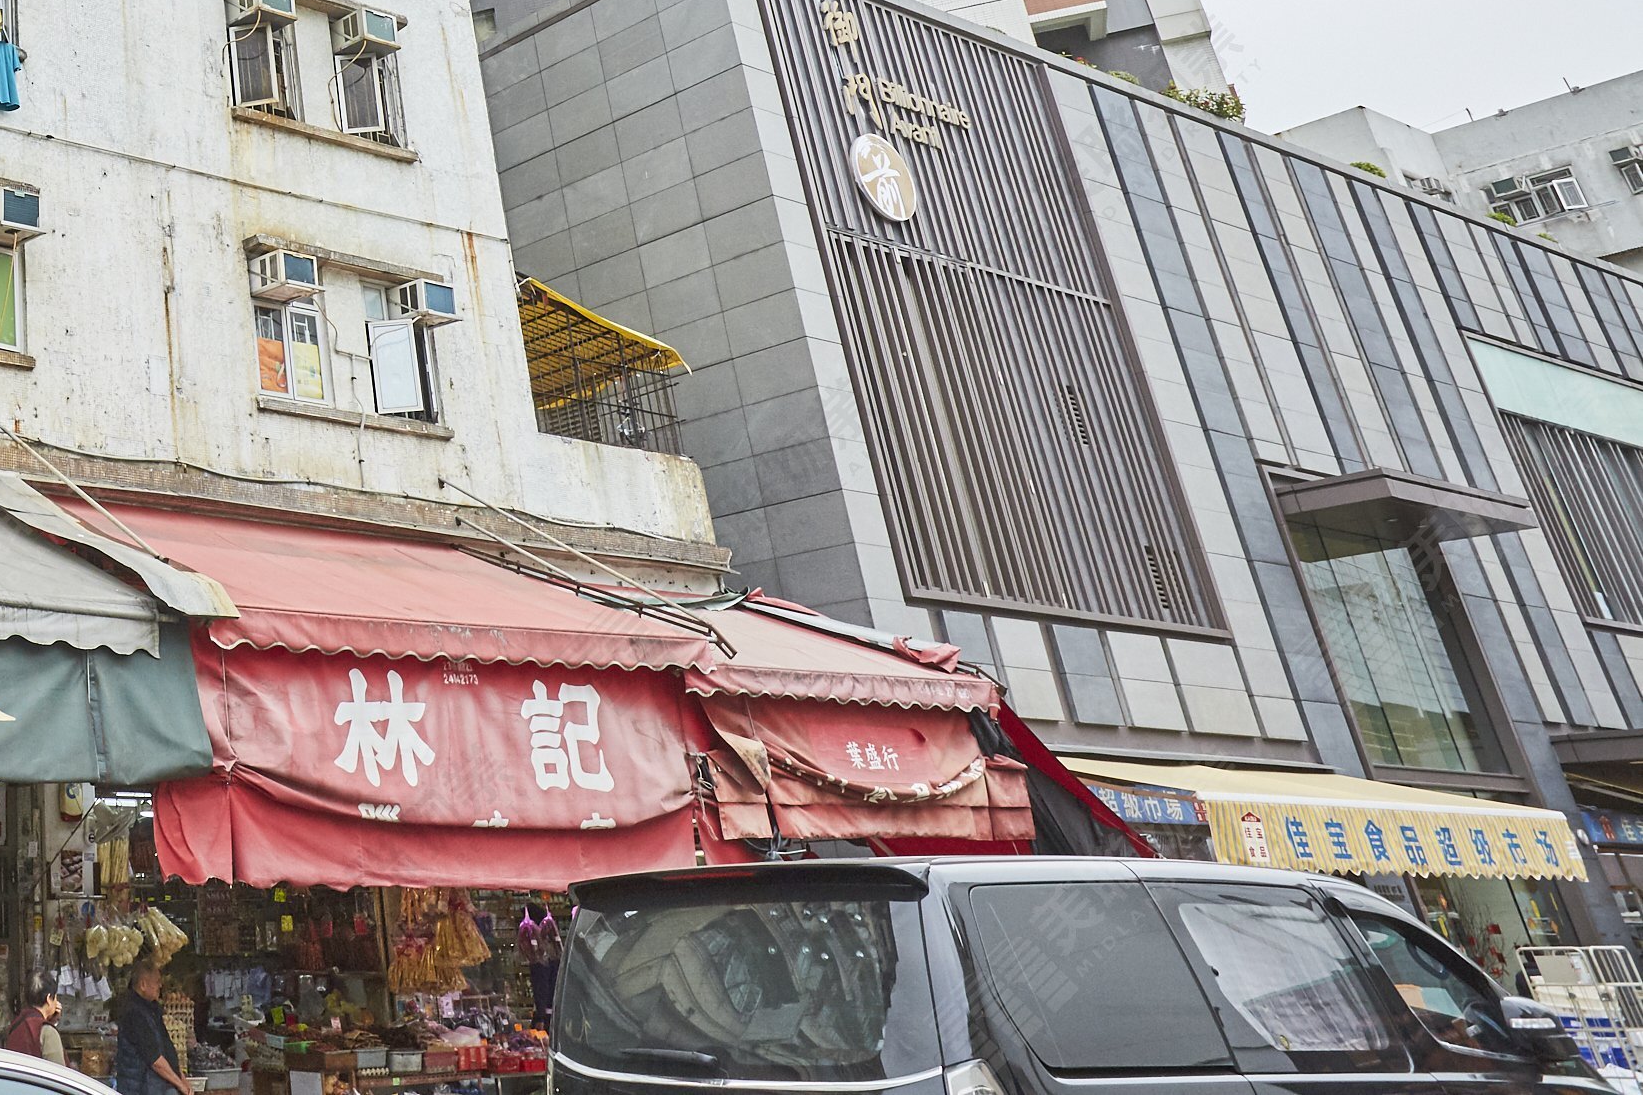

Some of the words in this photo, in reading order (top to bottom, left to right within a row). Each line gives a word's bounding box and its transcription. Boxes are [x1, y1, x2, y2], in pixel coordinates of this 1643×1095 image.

[876, 76, 972, 130] Billionnaire
[890, 111, 942, 152] Avant
[333, 668, 615, 792] 林記
[1098, 788, 1184, 822] 超級市場
[1285, 816, 1562, 867] 佳宝食品超级市场
